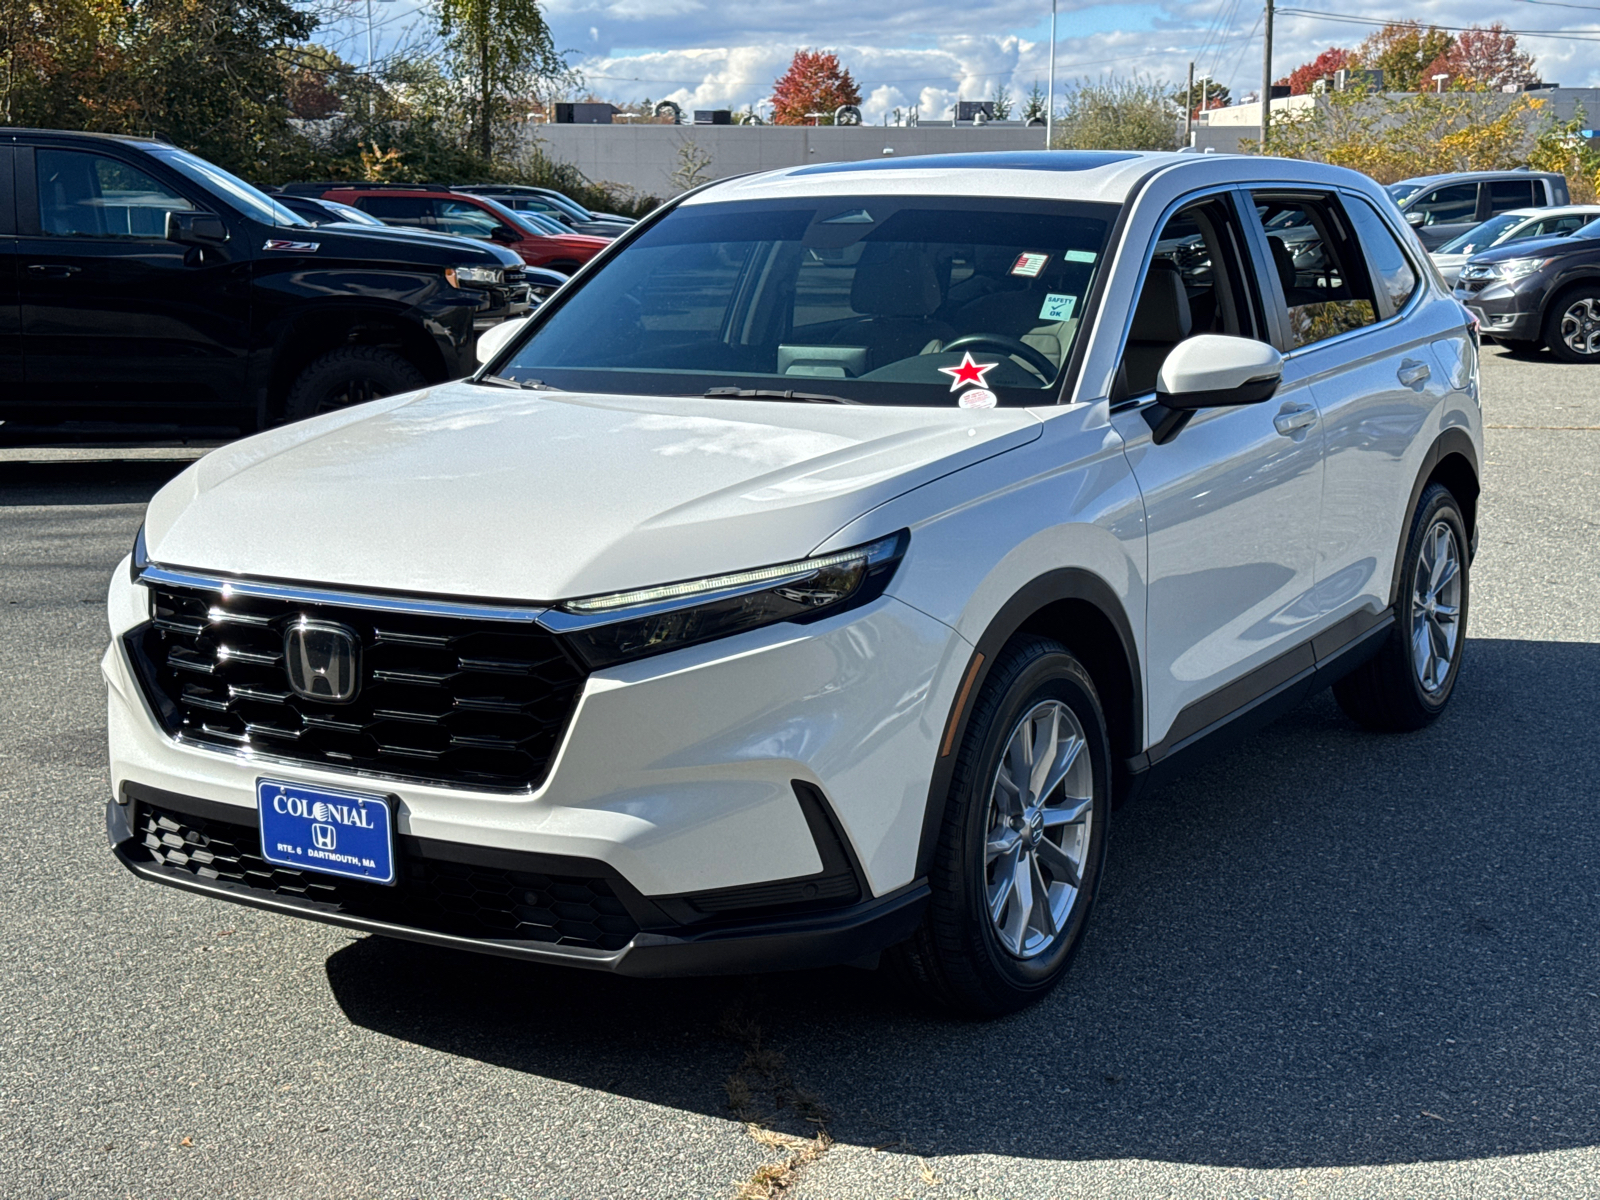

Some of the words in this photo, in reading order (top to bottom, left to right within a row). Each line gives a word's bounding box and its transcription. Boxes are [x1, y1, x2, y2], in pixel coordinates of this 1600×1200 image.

[262, 239, 321, 252] Z71
[273, 795, 374, 829] COLONIAL
[277, 844, 295, 853] RTE.
[296, 847, 302, 855] 6
[308, 850, 361, 867] DARTMOUTH,
[362, 858, 376, 868] MA
